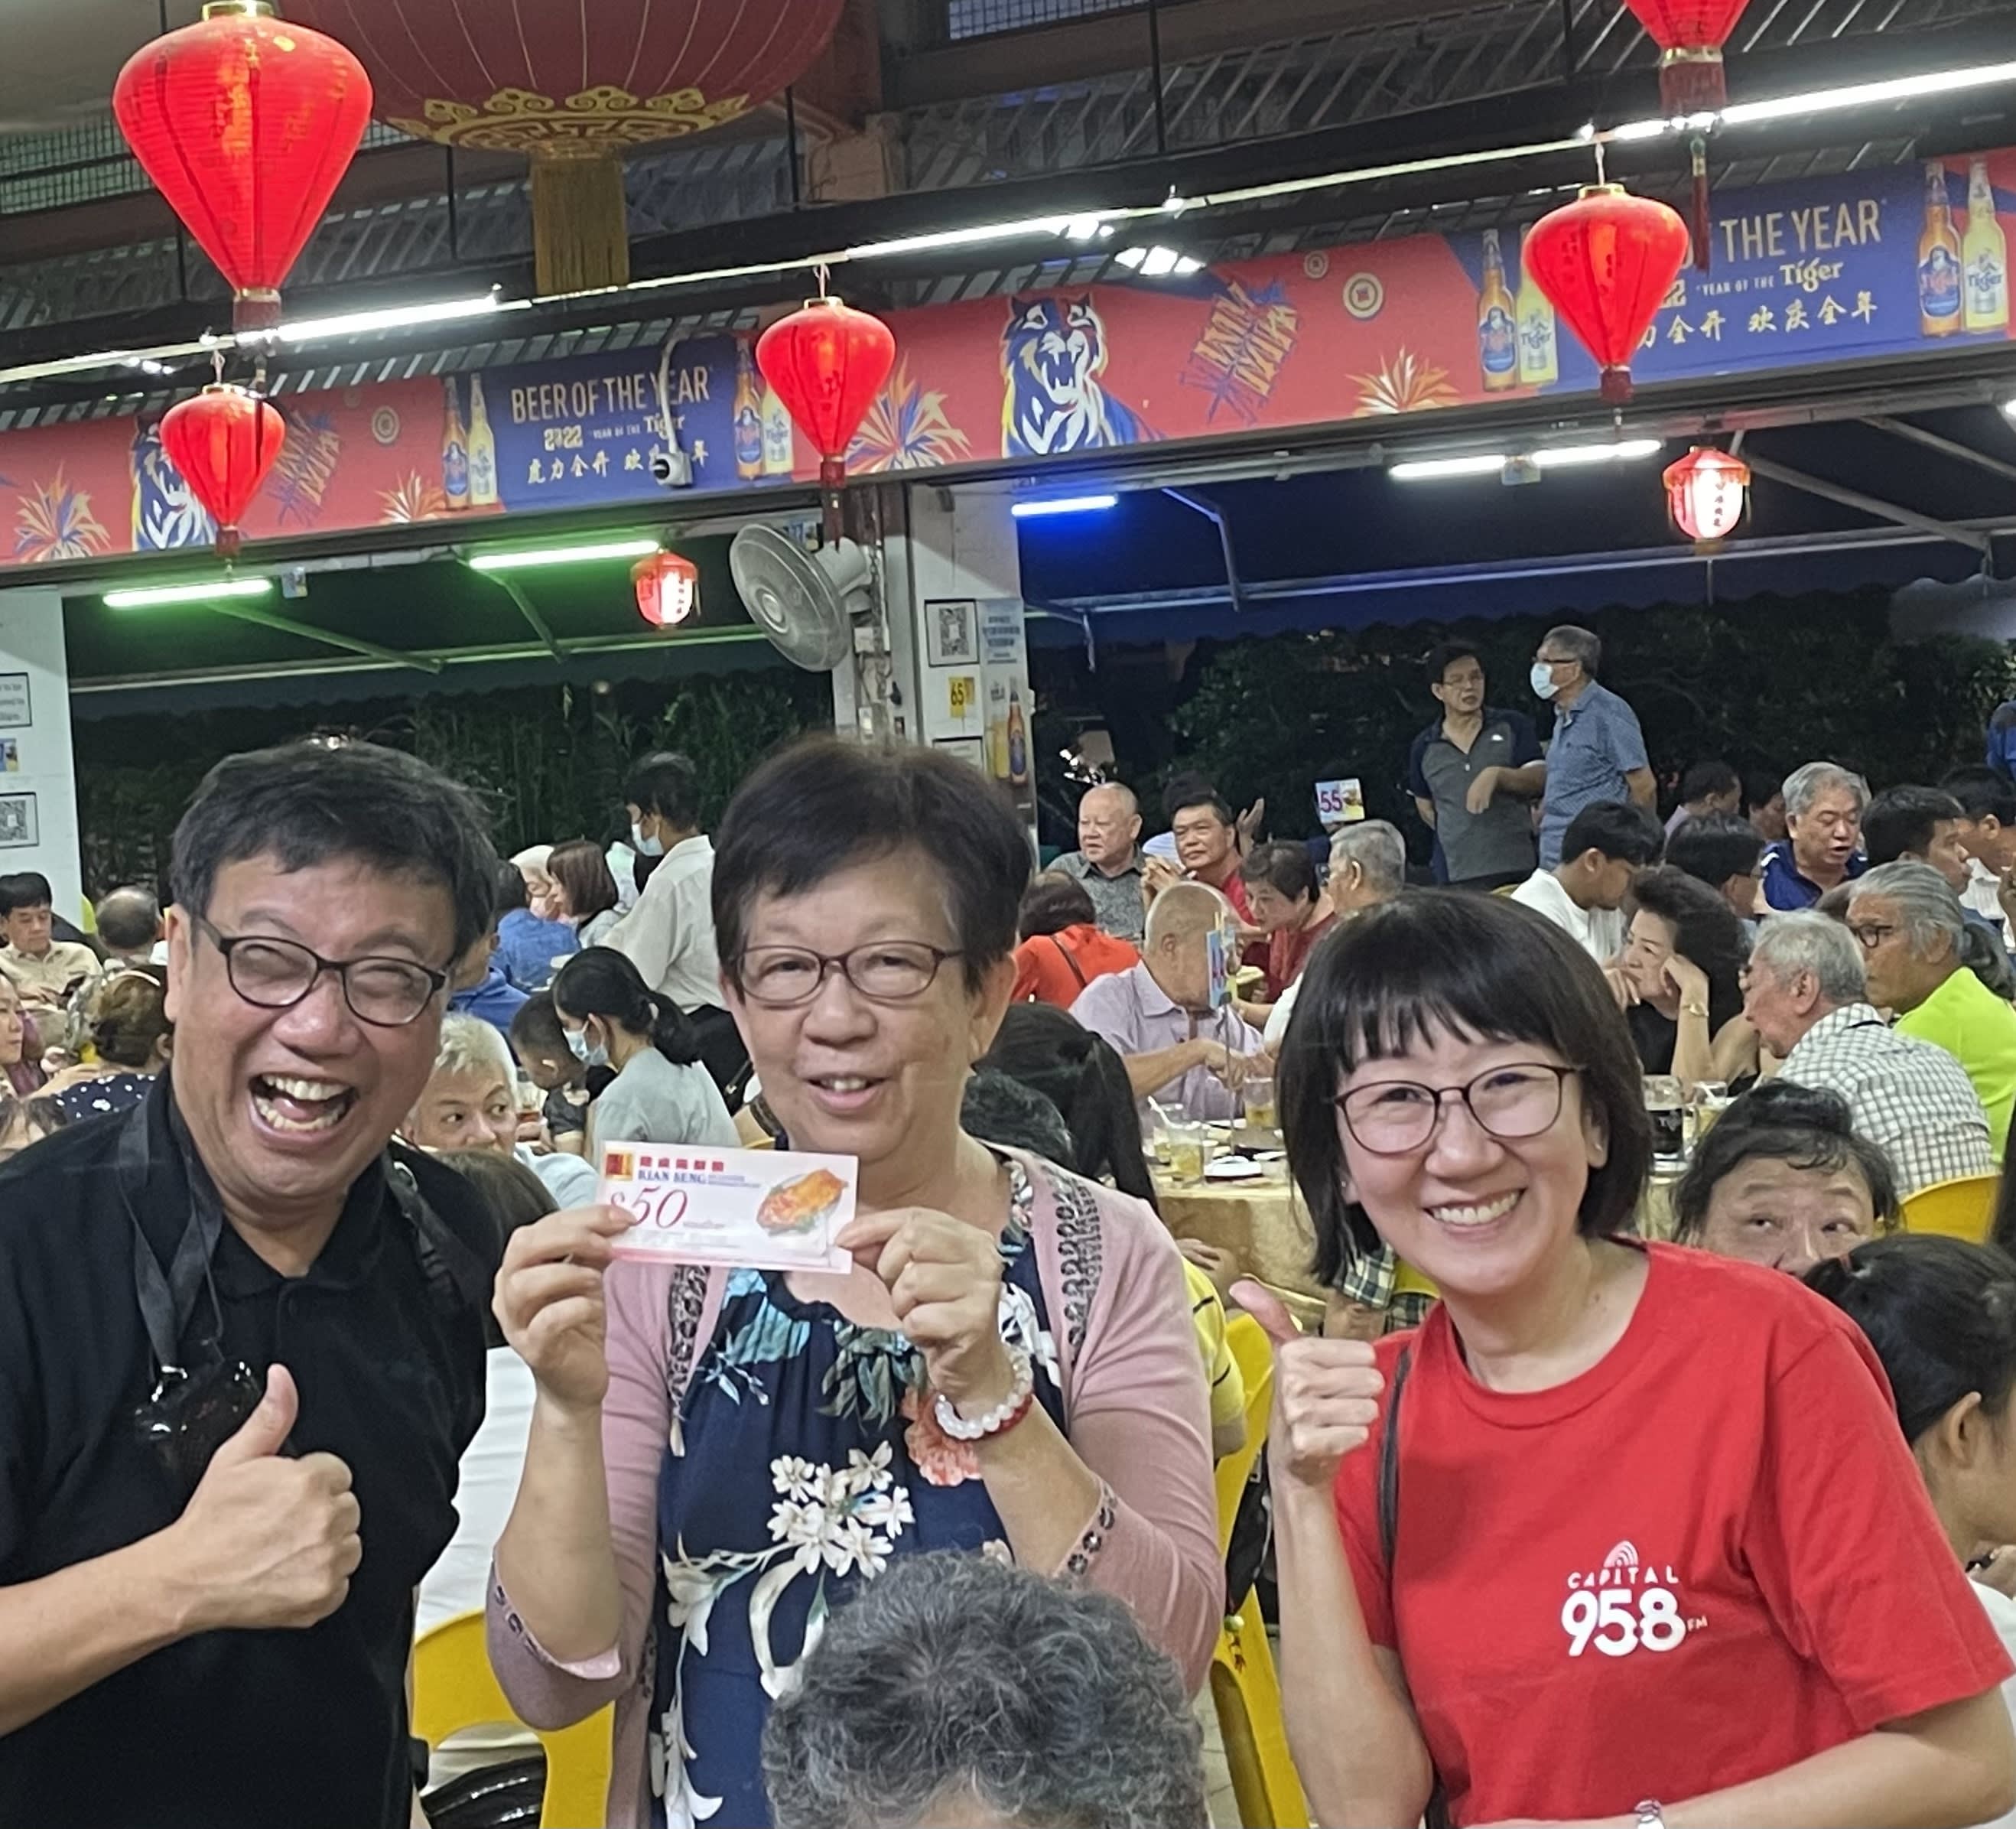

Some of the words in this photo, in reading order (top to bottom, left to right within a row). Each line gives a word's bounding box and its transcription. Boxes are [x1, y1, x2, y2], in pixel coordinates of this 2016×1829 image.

[1720, 211, 1786, 263] THE
[1790, 199, 1881, 253] YEAR
[1780, 257, 1844, 293] Tiger
[1637, 309, 1726, 349] 力全开
[511, 382, 569, 424] BEER
[571, 379, 600, 418] OF
[603, 373, 647, 413] THE
[544, 424, 584, 451] 2022
[643, 412, 686, 441] Tigr
[951, 682, 964, 705] 65
[1320, 789, 1343, 813] 55
[1567, 1565, 1679, 1590] CAPITAL
[1561, 1587, 1686, 1657] 958
[1687, 1615, 1708, 1632] FM
